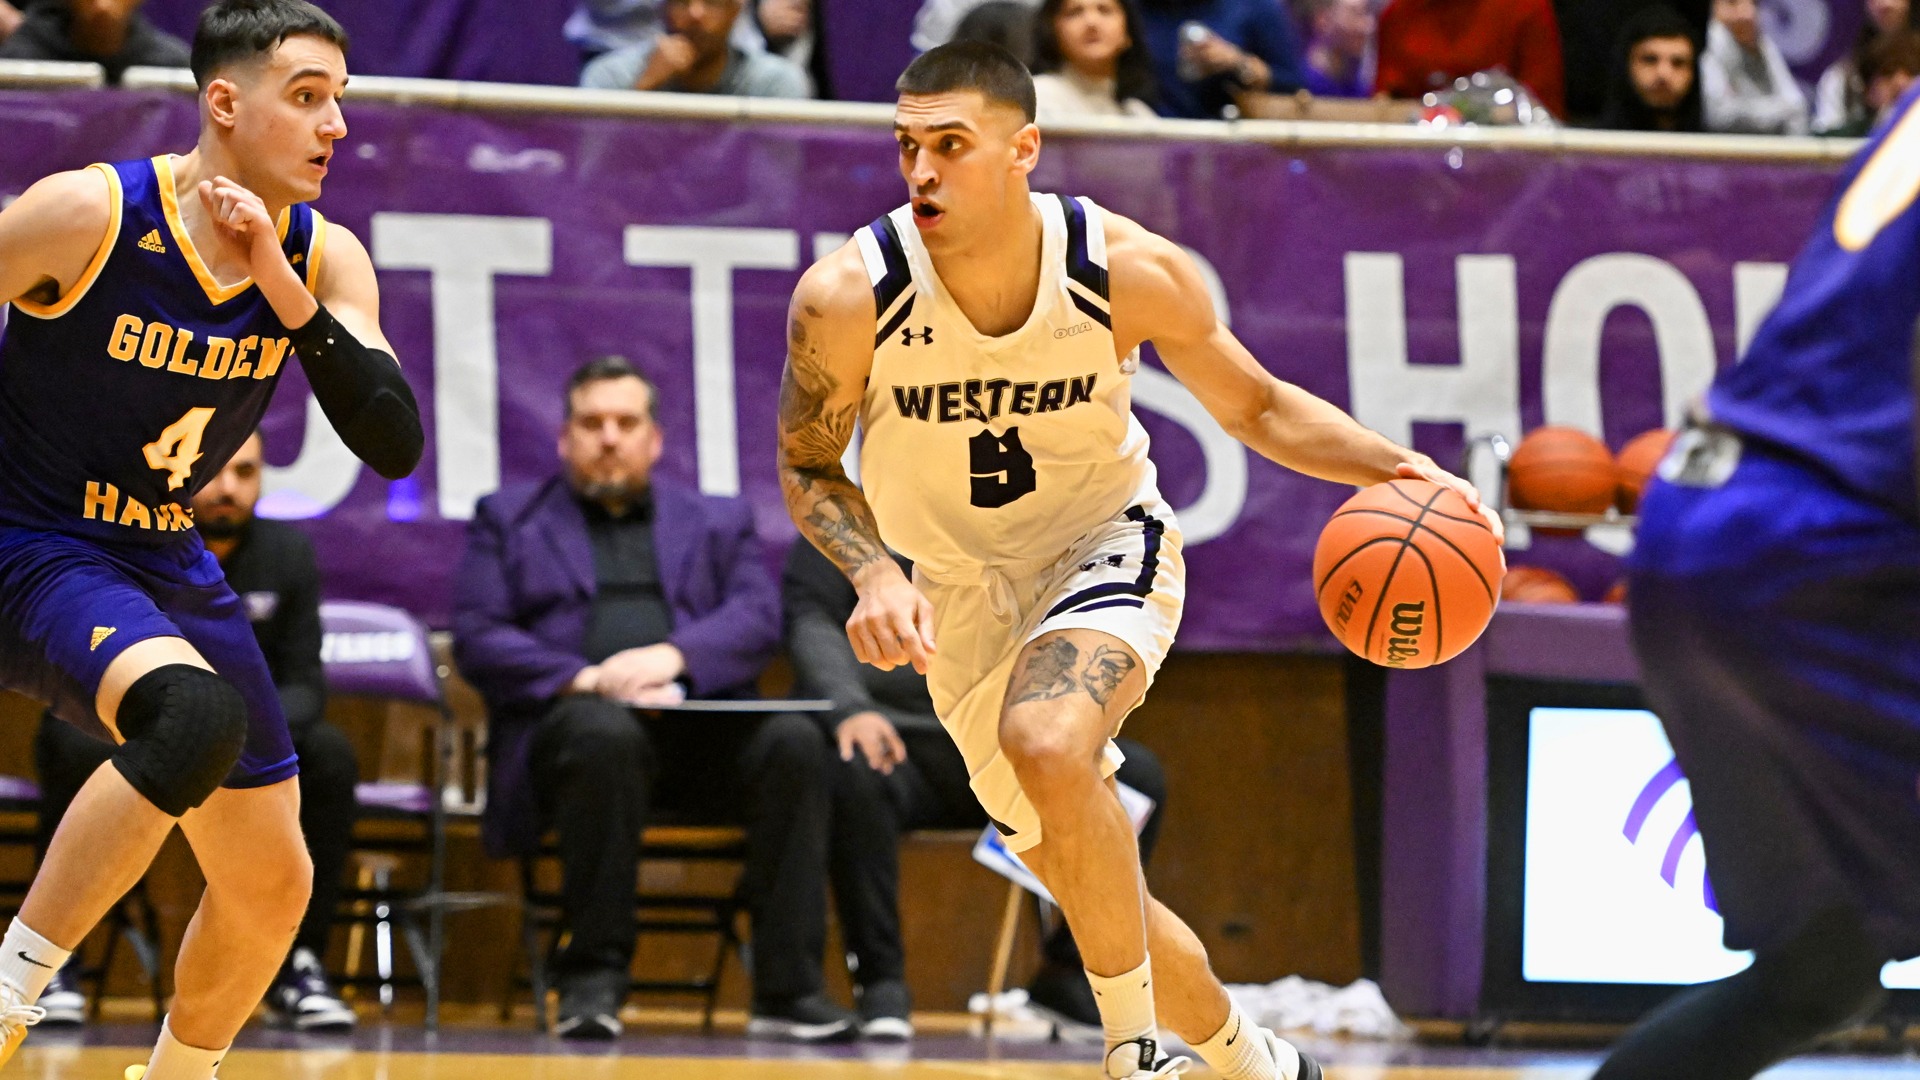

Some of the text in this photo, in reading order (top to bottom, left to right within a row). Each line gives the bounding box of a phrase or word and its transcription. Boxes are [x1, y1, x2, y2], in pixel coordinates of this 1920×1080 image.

[137, 240, 166, 254] adidas
[106, 313, 291, 380] GOLDEN
[1053, 321, 1093, 339] OUA
[891, 372, 1098, 424] WESTERN
[141, 406, 217, 492] 4
